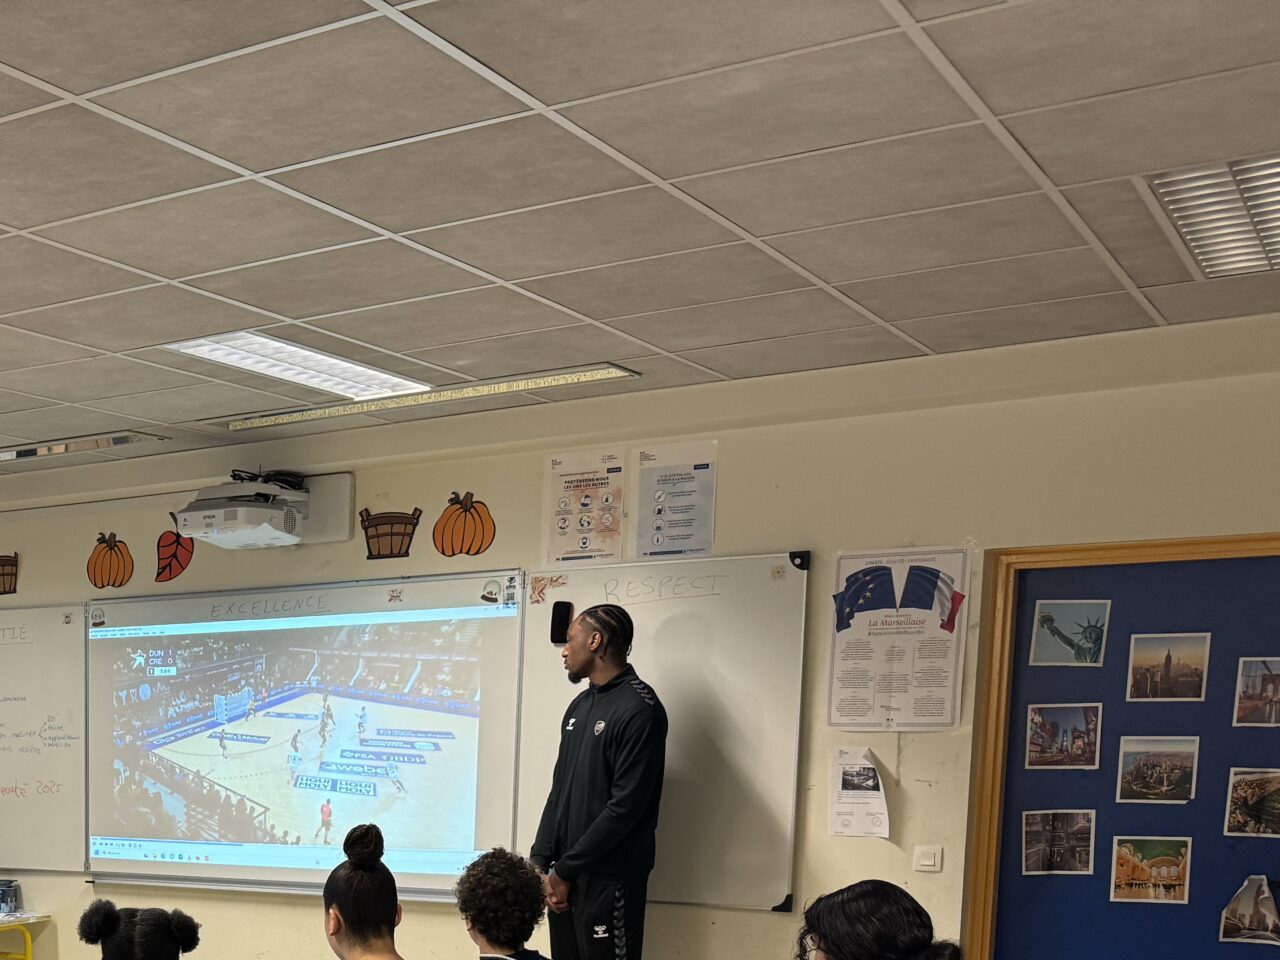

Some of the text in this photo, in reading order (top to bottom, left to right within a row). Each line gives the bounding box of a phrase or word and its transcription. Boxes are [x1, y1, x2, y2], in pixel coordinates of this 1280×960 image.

[604, 575, 729, 602] RESPECT
[211, 593, 329, 617] EXCELLENCE
[868, 618, 927, 627] La Marseillaise
[338, 764, 388, 776] webe
[300, 776, 330, 784] LIQUI
[299, 782, 372, 795] MOLY MOLY
